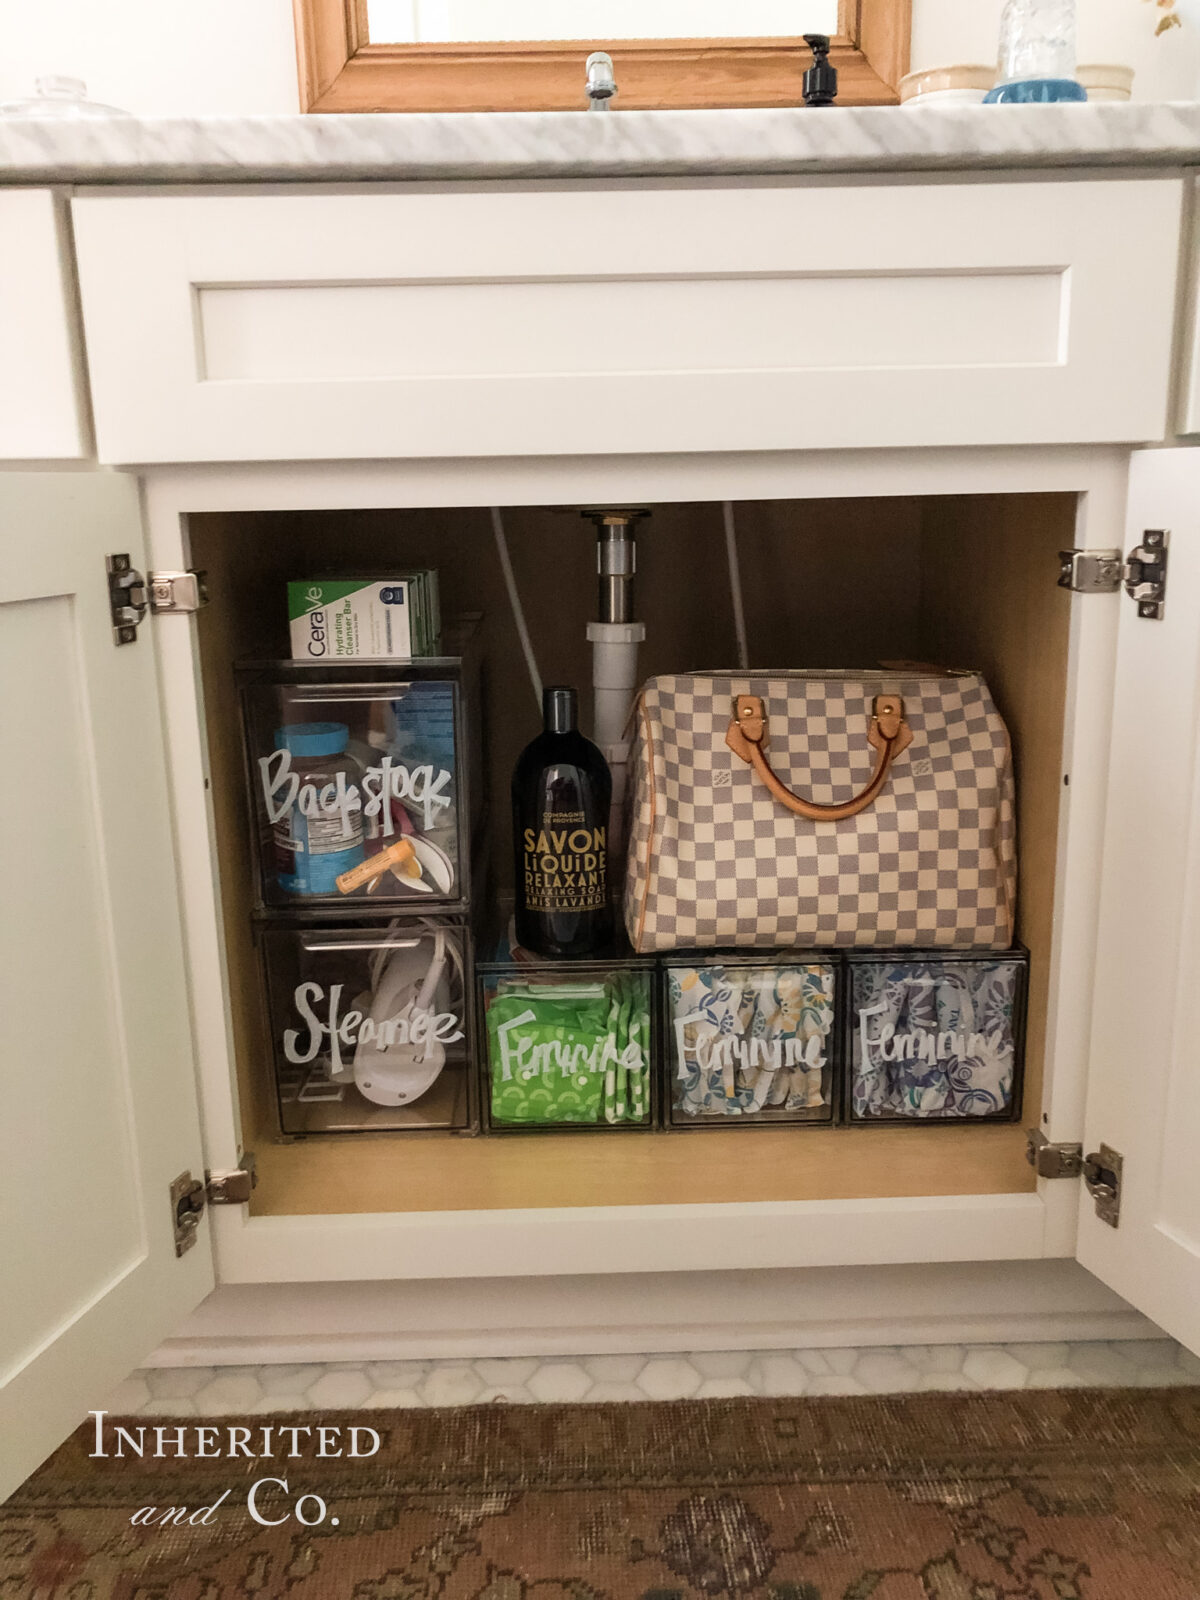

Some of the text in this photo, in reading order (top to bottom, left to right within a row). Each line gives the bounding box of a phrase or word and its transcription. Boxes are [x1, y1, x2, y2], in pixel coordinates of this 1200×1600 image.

[305, 586, 326, 657] CeraVe
[336, 612, 344, 656] Hydrating
[343, 599, 354, 656] Cleanser Bar
[524, 826, 606, 854] SAVON
[524, 869, 606, 888] RELAXANT
[525, 885, 576, 896] RELAXING
